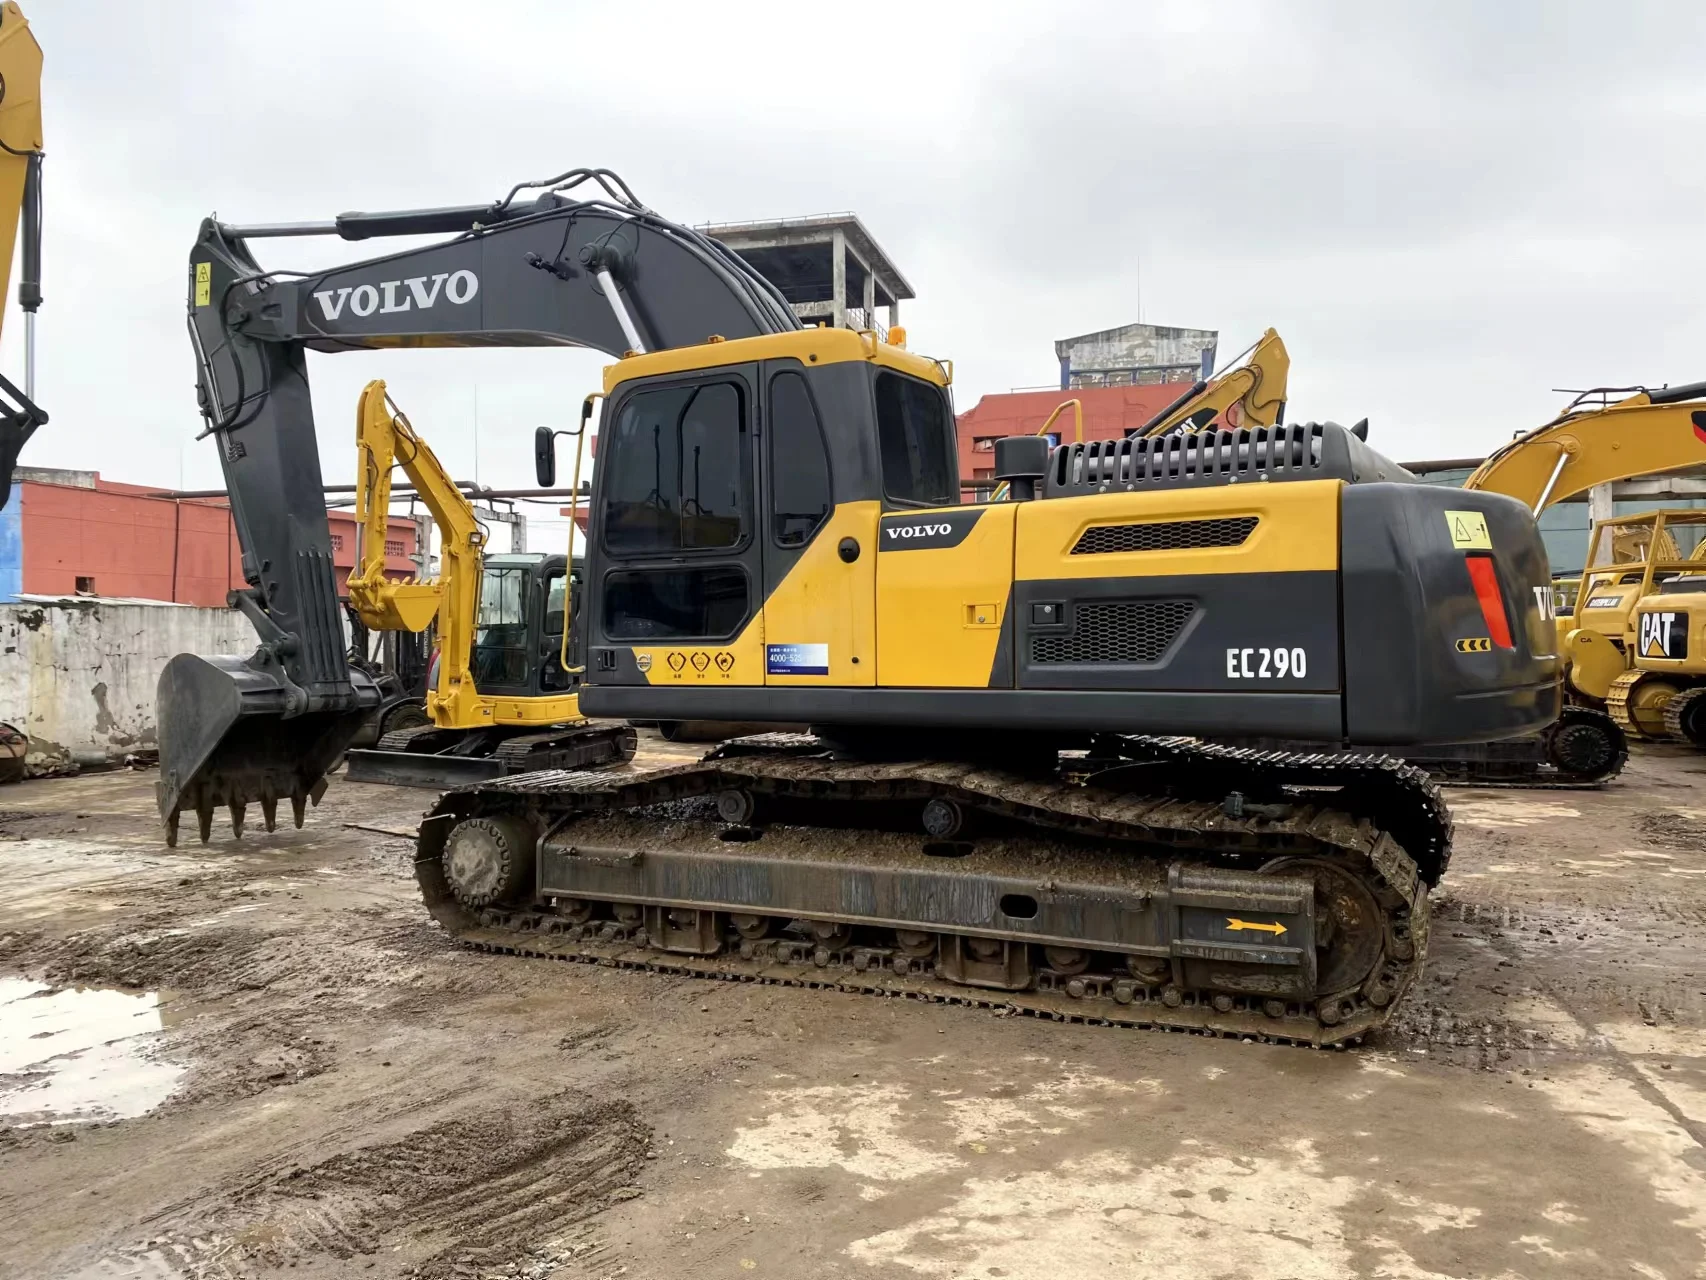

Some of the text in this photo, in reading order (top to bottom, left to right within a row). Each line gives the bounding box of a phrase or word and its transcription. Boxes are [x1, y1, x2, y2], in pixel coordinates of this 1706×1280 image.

[313, 269, 479, 321] VOLVO
[886, 523, 952, 539] VOLVO
[1641, 612, 1675, 657] CAT
[1226, 647, 1307, 678] EC290
